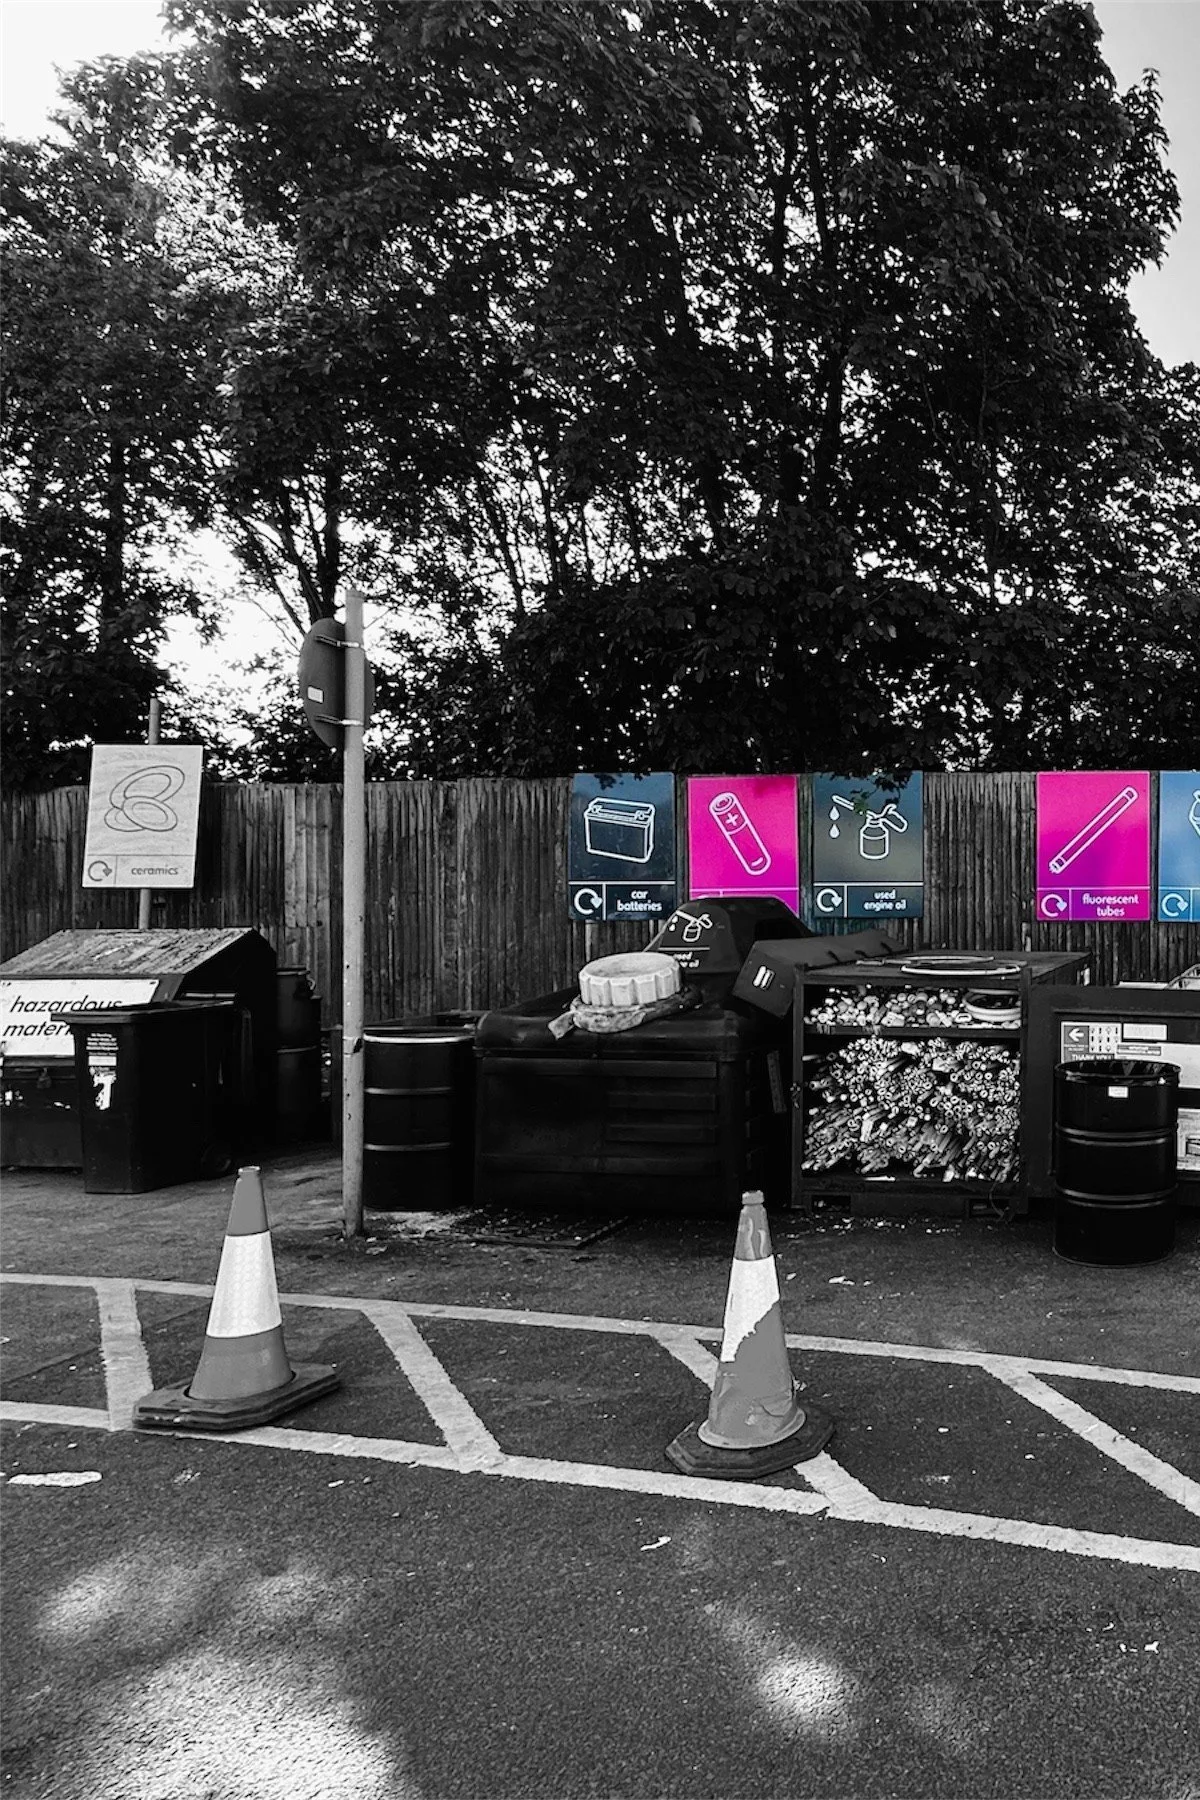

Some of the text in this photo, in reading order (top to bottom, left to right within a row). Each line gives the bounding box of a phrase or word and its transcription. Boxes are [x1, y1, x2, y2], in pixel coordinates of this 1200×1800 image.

[131, 864, 179, 875] ceramics
[630, 890, 649, 899] car
[874, 889, 896, 900] used
[1082, 893, 1139, 904] fluorescent
[616, 899, 662, 911] batteries
[863, 899, 907, 911] engine oil
[1096, 905, 1125, 917] tubes
[689, 959, 700, 968] oil
